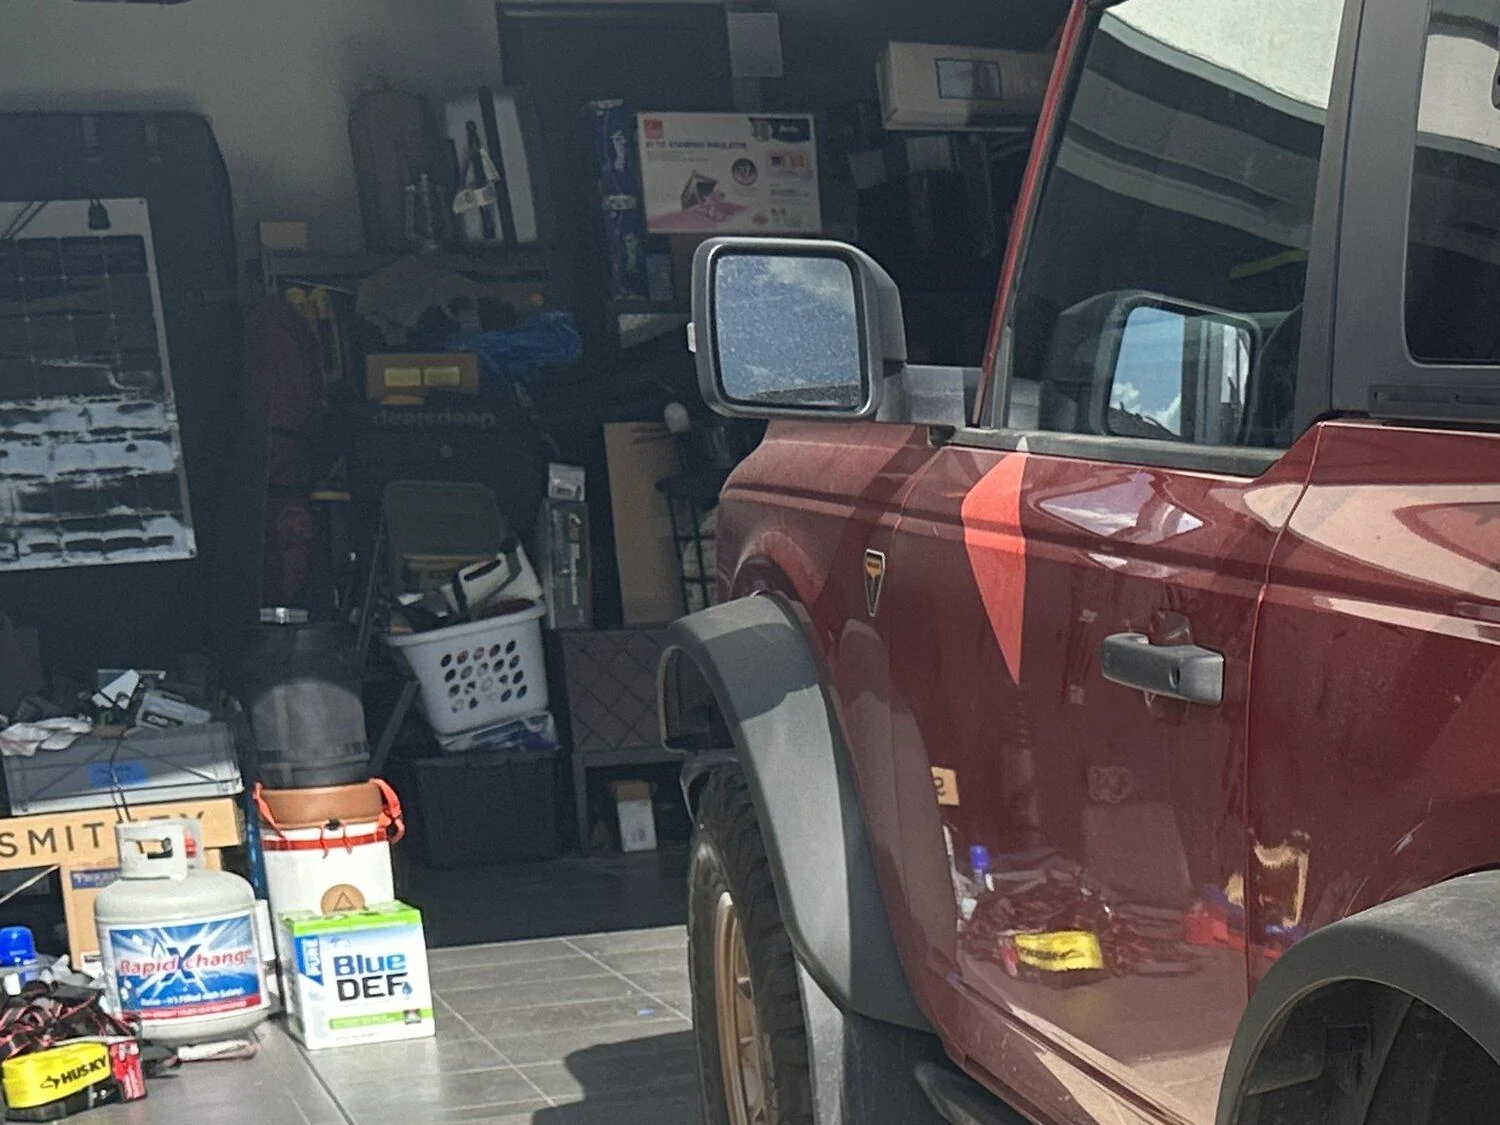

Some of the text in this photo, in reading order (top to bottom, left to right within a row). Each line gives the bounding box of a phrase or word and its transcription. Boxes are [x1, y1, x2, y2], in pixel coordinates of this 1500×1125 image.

[333, 953, 406, 976] Blue
[336, 972, 408, 1002] DEF
[60, 1055, 107, 1085] HUSKY
